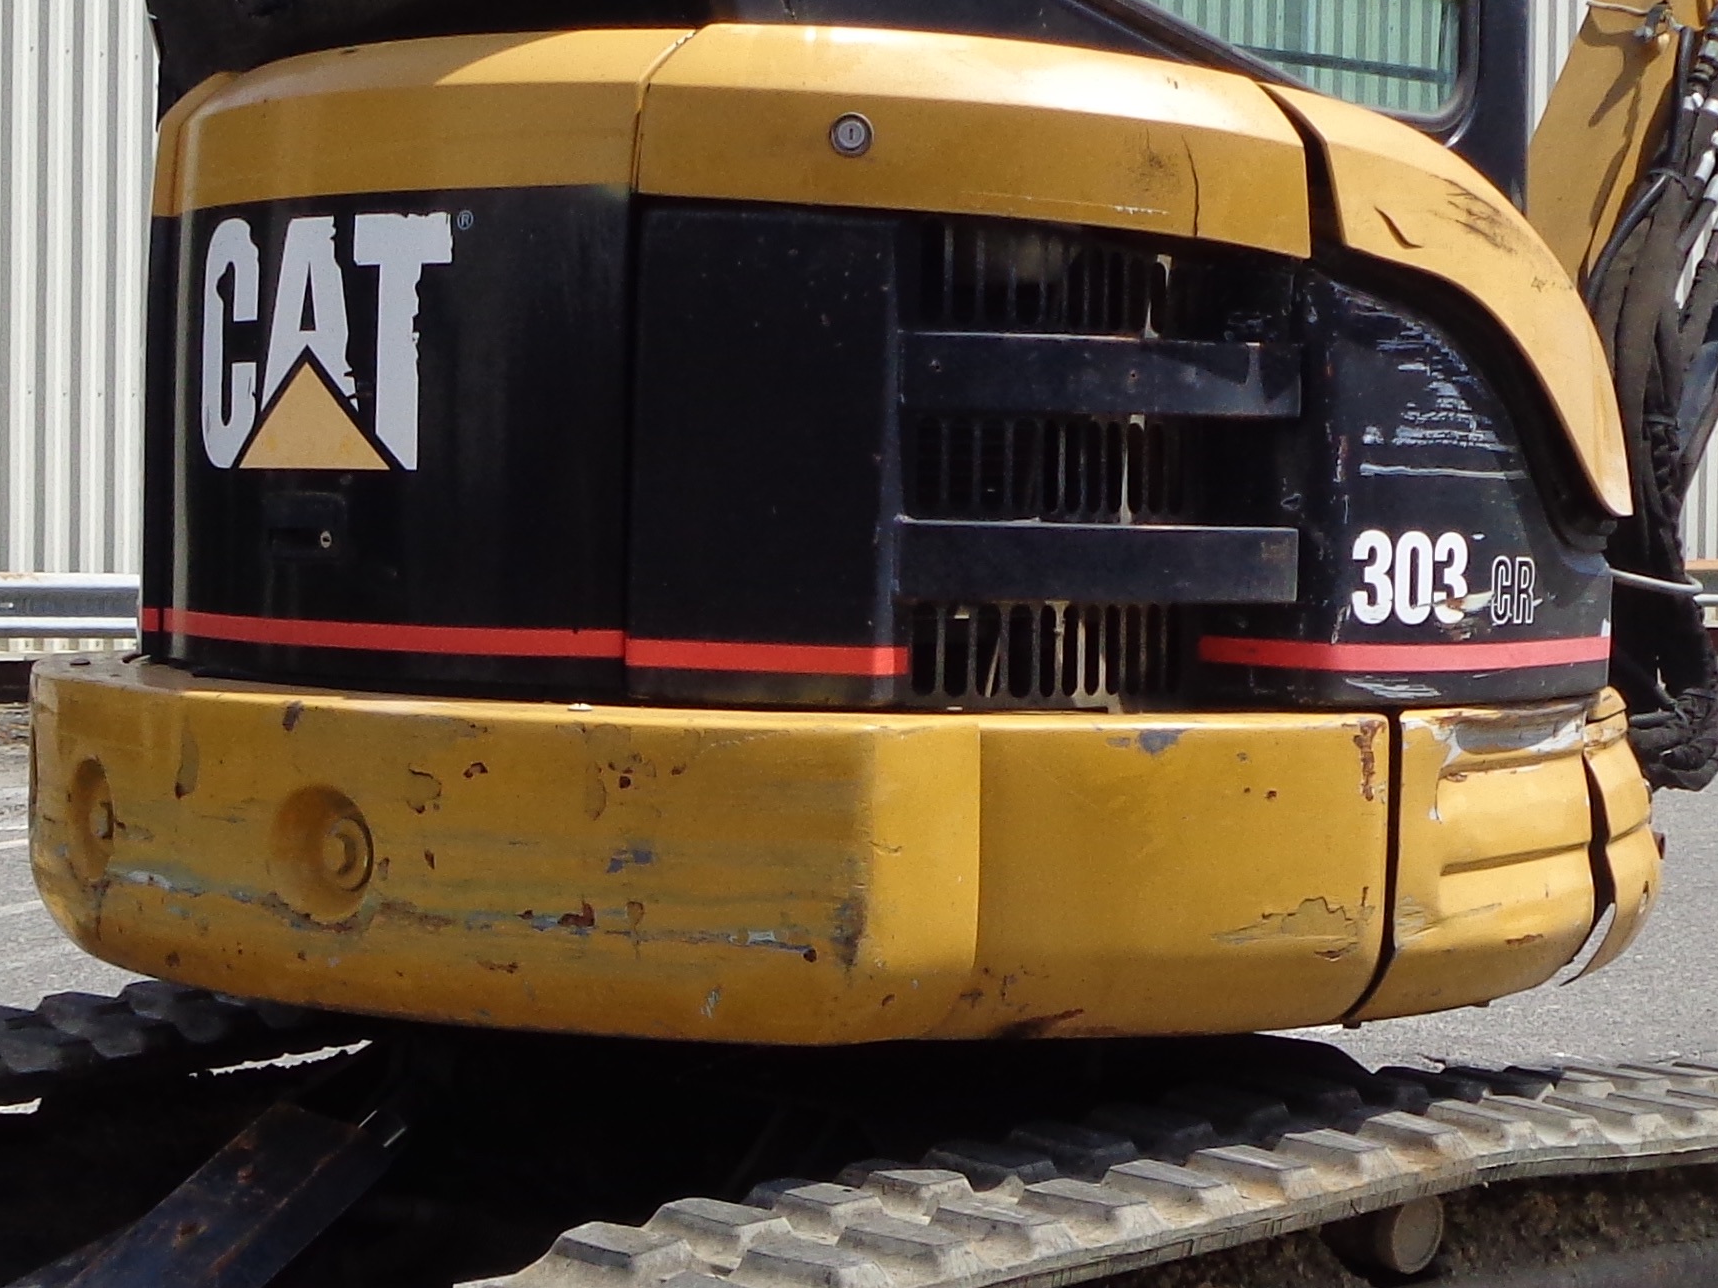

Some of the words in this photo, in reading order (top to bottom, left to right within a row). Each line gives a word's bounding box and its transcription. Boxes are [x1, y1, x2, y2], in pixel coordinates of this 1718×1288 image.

[201, 212, 453, 471] CAT
[1351, 528, 1469, 625] 303
[1490, 554, 1536, 625] CR
